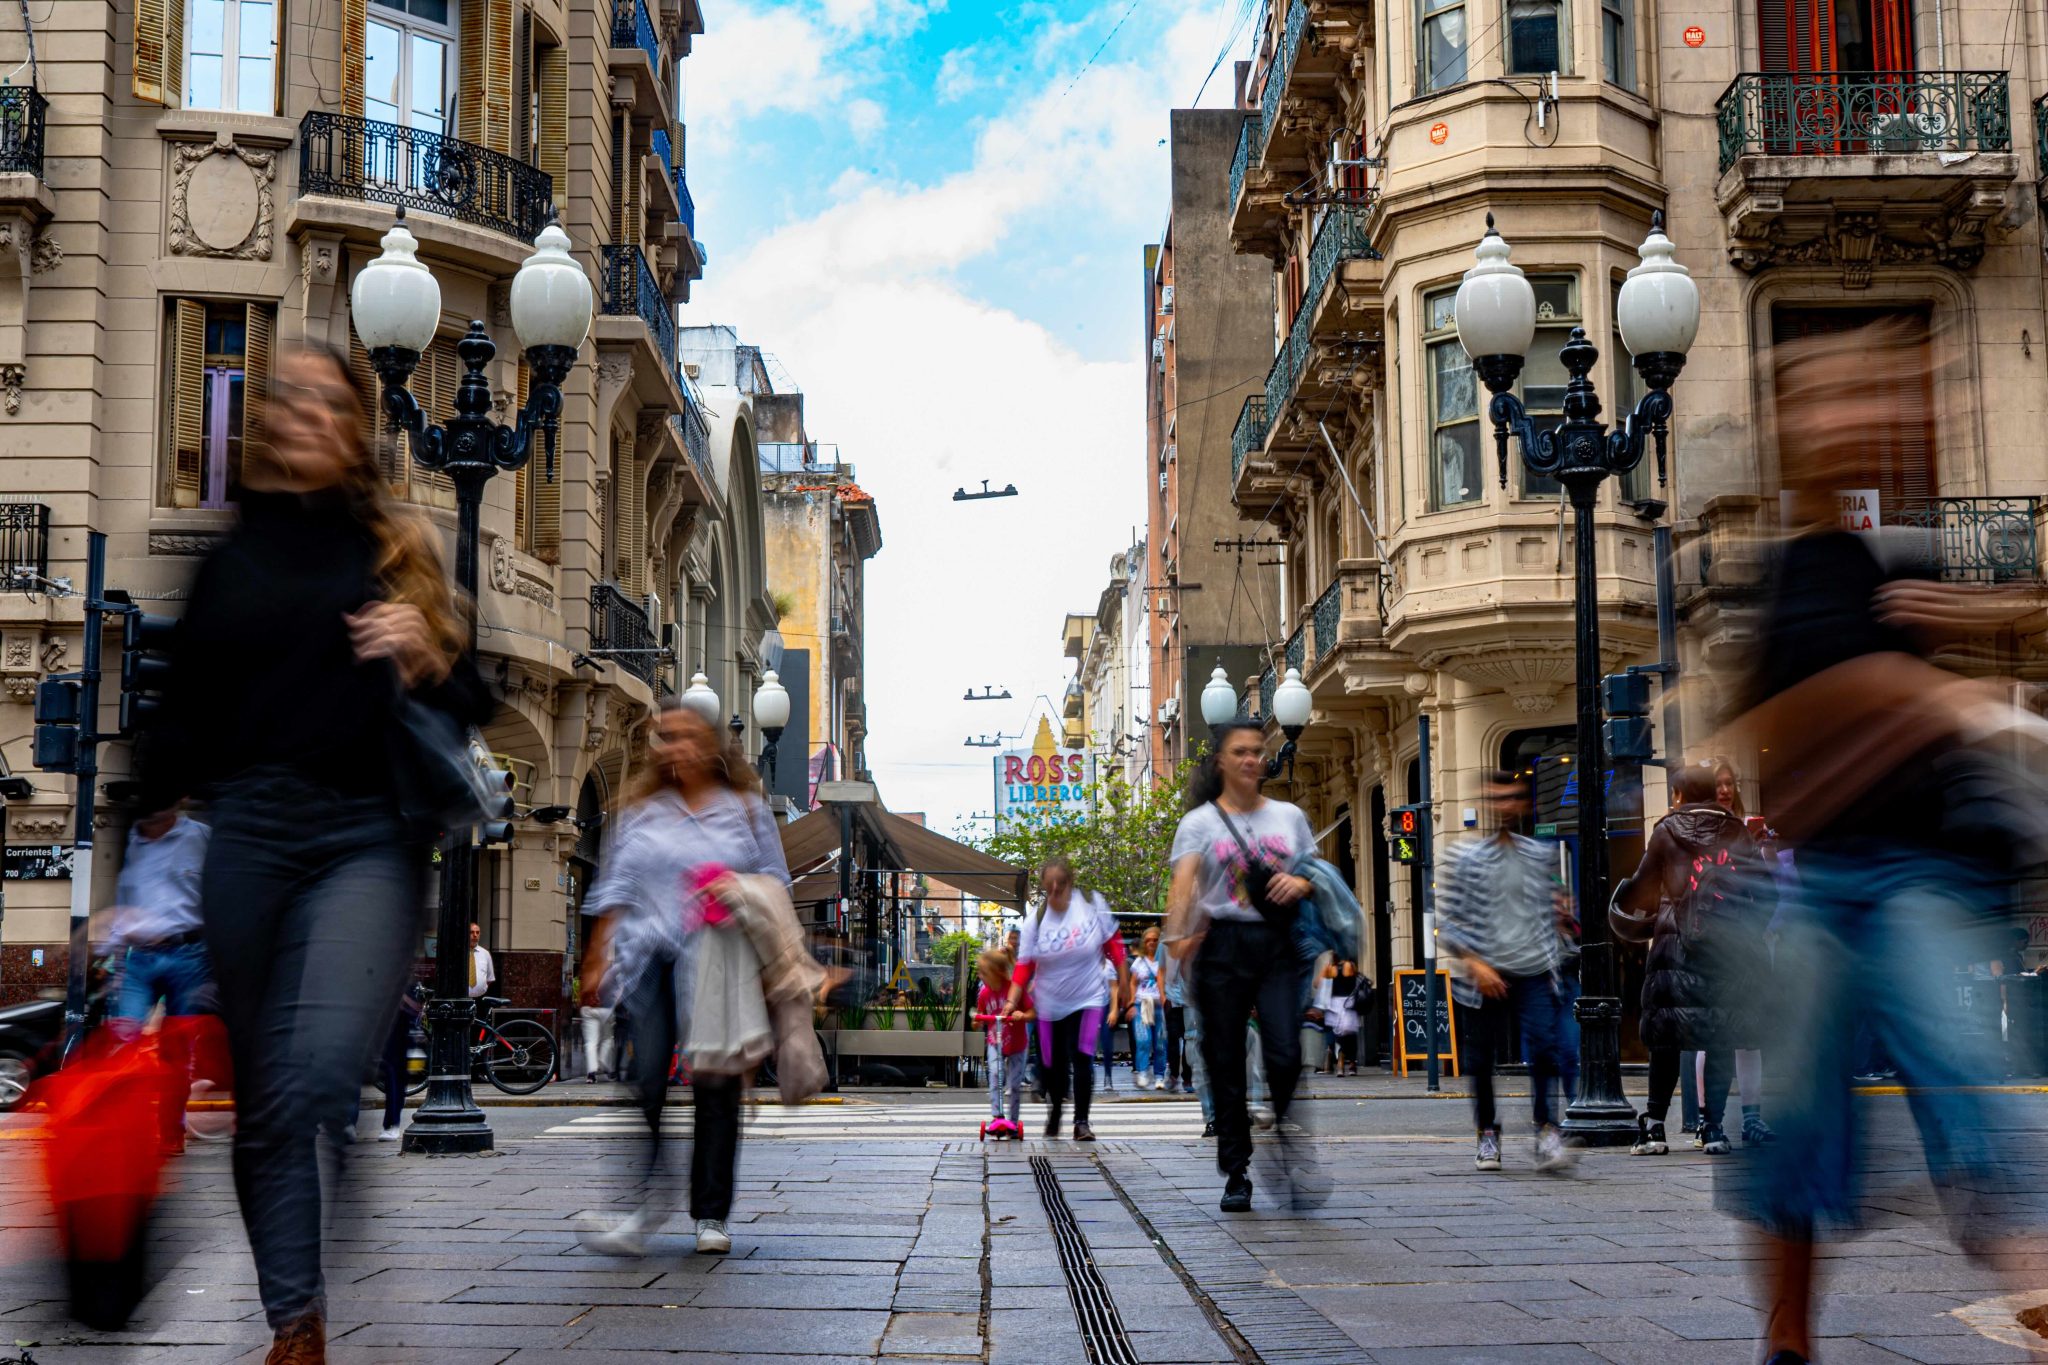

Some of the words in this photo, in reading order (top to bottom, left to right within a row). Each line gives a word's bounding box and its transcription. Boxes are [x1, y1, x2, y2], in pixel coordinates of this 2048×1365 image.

[1004, 754, 1083, 785] ROSS
[1009, 784, 1083, 802] LIBRERO
[1402, 811, 1413, 832] 8
[6, 848, 51, 856] Corrientes
[886, 958, 918, 989] A
